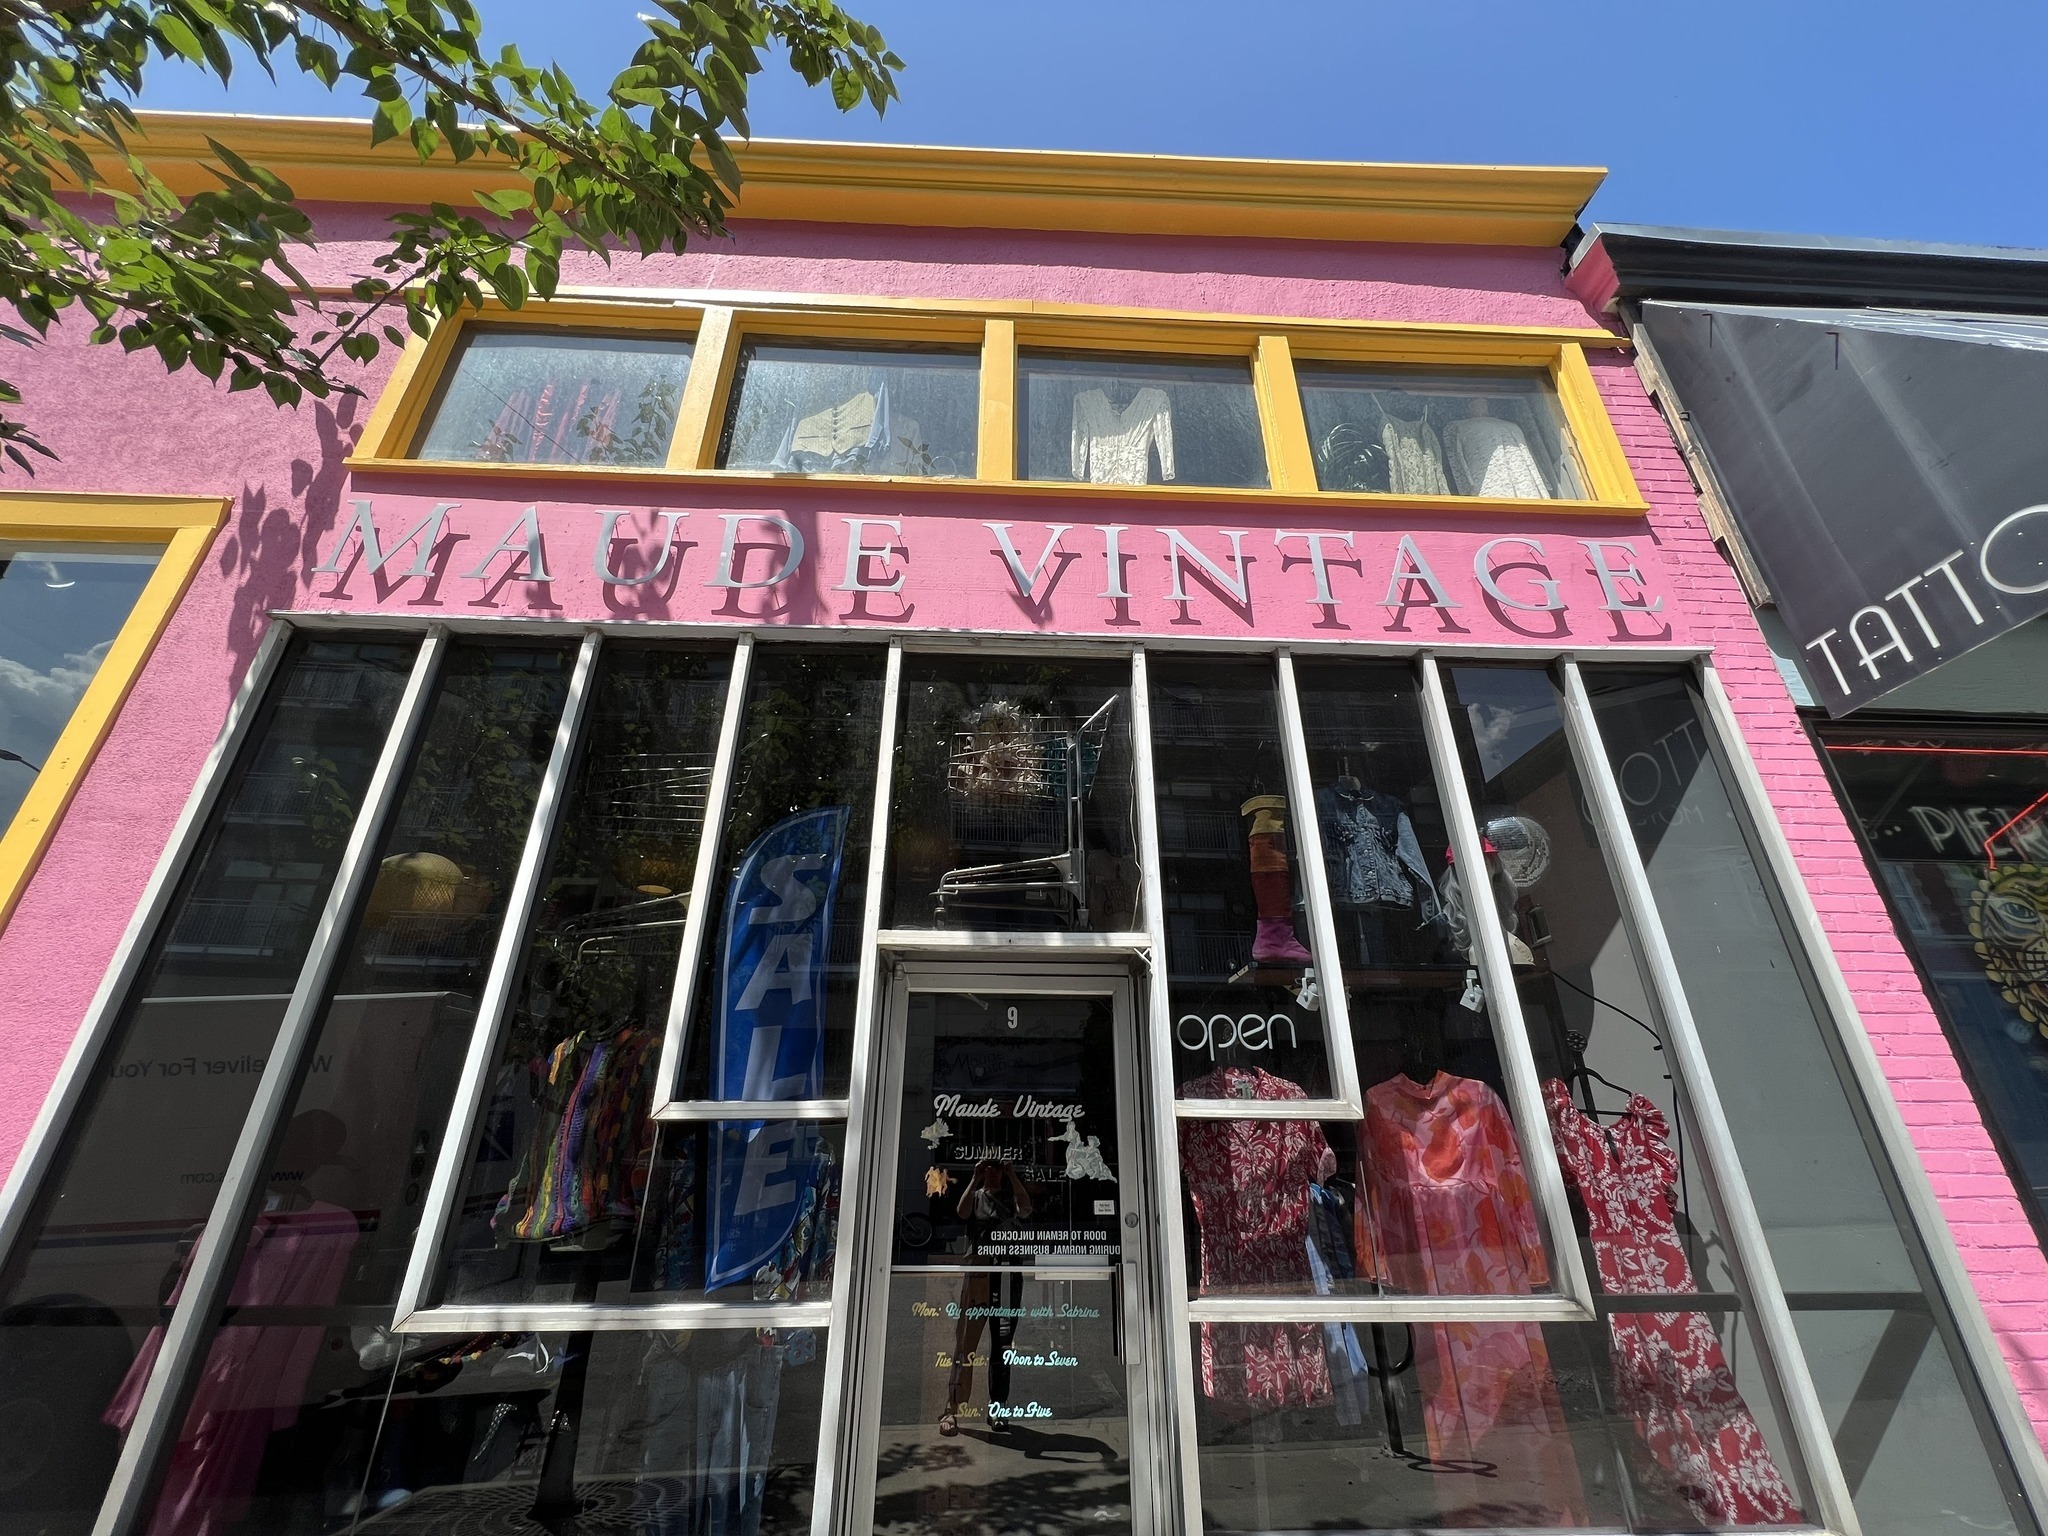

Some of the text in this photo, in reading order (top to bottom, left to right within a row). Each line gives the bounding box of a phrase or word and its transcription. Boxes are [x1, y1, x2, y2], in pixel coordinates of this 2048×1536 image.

[311, 500, 1664, 613] MAUDE VINTAGE
[1007, 1006, 1018, 1029] 9
[733, 854, 823, 1217] SALE
[1176, 1013, 1297, 1062] open
[933, 1093, 1086, 1123] Maude Vintage
[954, 1145, 1023, 1161] SUMMER
[912, 1302, 1100, 1320] Mon: By appointment with Sabrina
[935, 1352, 953, 1367] Tue
[1002, 1350, 1032, 1366] Noon
[1033, 1353, 1044, 1366] to
[1044, 1350, 1078, 1367] Seven
[955, 1402, 1053, 1418] Sun: One to Five
